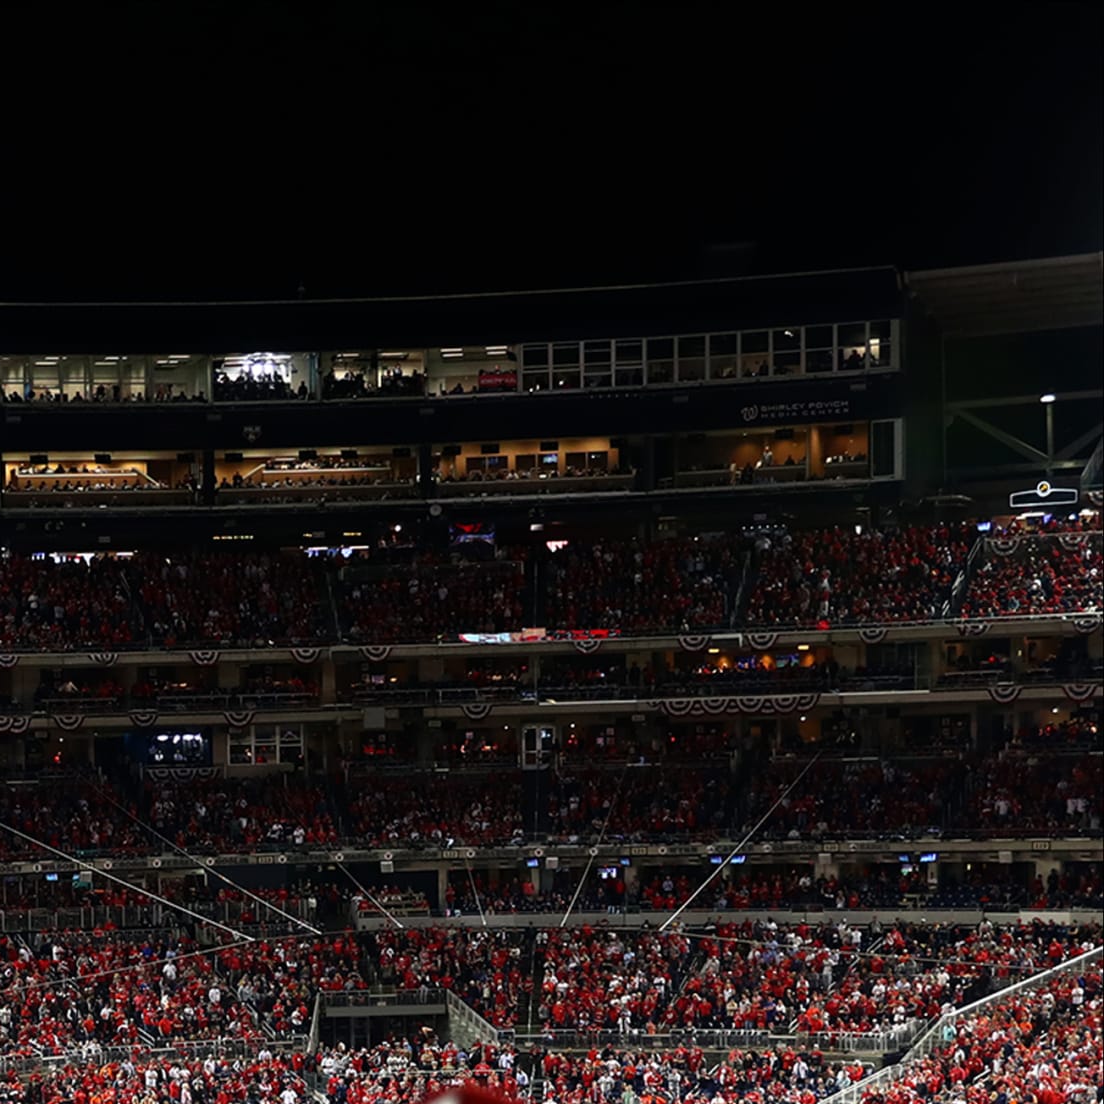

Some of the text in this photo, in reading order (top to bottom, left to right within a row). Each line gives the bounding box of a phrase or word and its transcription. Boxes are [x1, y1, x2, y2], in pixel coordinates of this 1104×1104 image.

[761, 400, 849, 413] SHIRLEY POVICH
[761, 408, 849, 419] MEDIA CENTER
